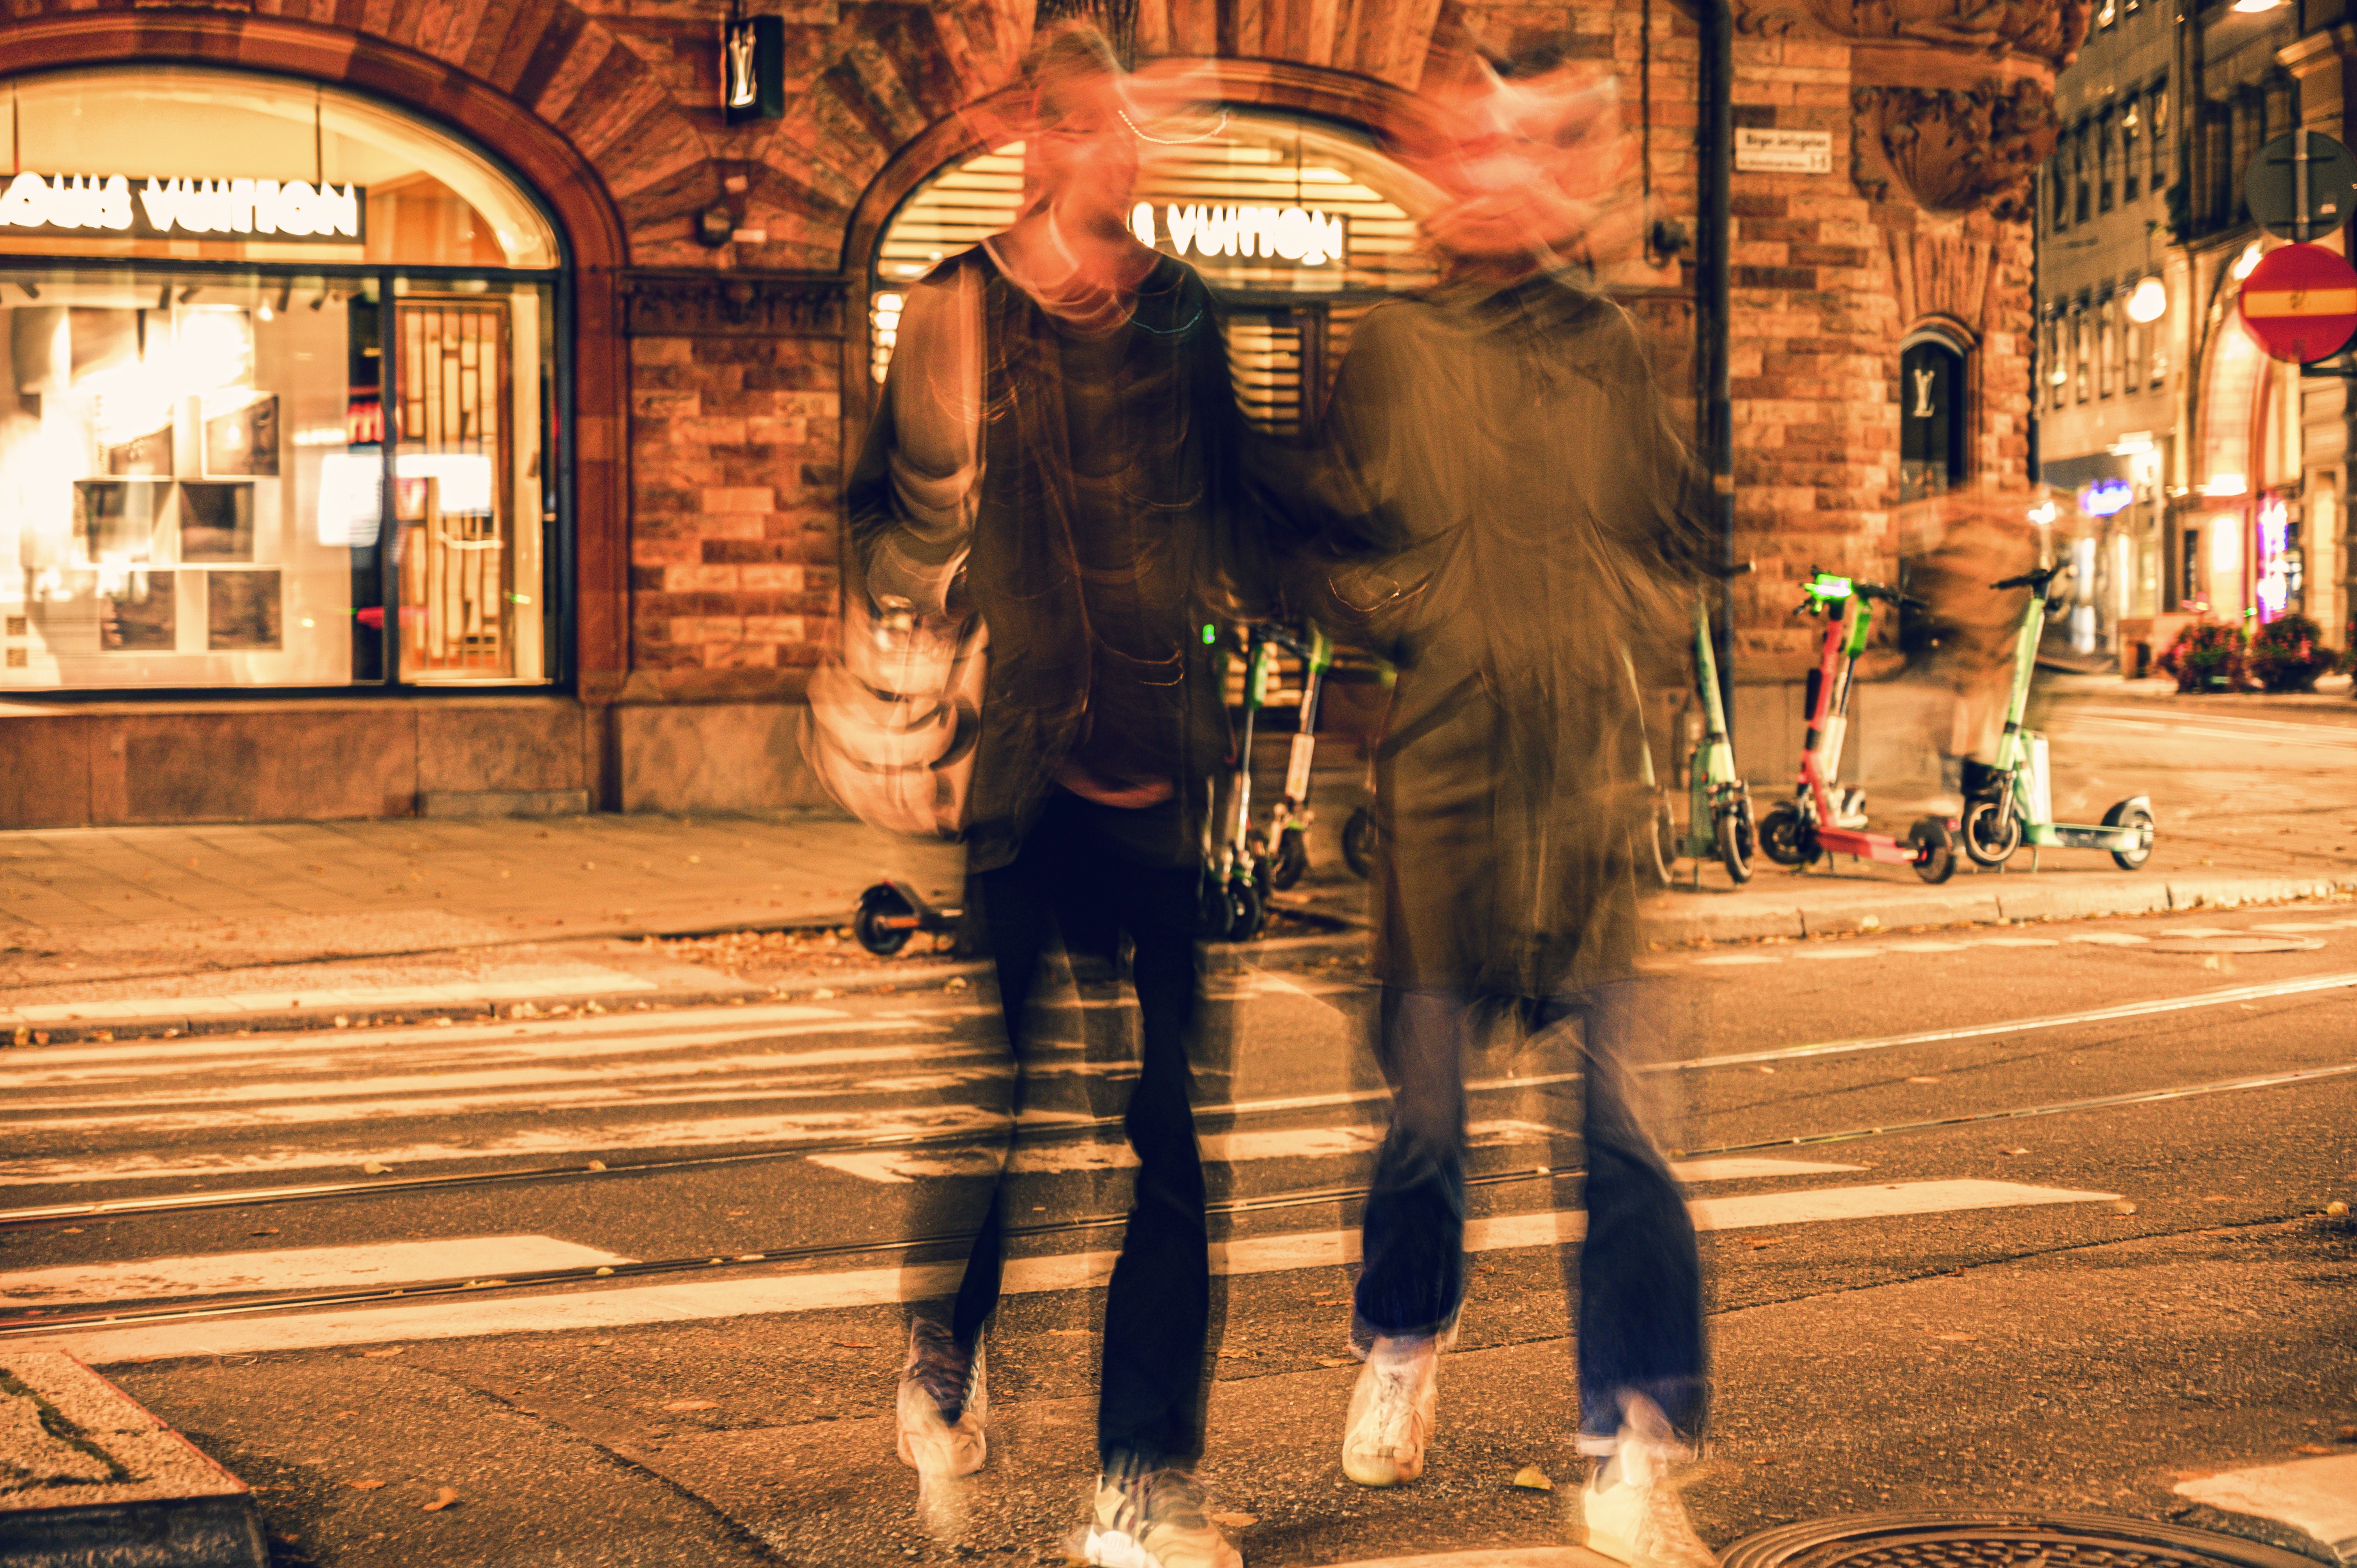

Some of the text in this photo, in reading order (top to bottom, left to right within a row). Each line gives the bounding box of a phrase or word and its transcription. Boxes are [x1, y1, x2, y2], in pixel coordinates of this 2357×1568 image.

[0, 171, 357, 237] OUIS VUITTON
[1167, 203, 1343, 260] VUITTON
